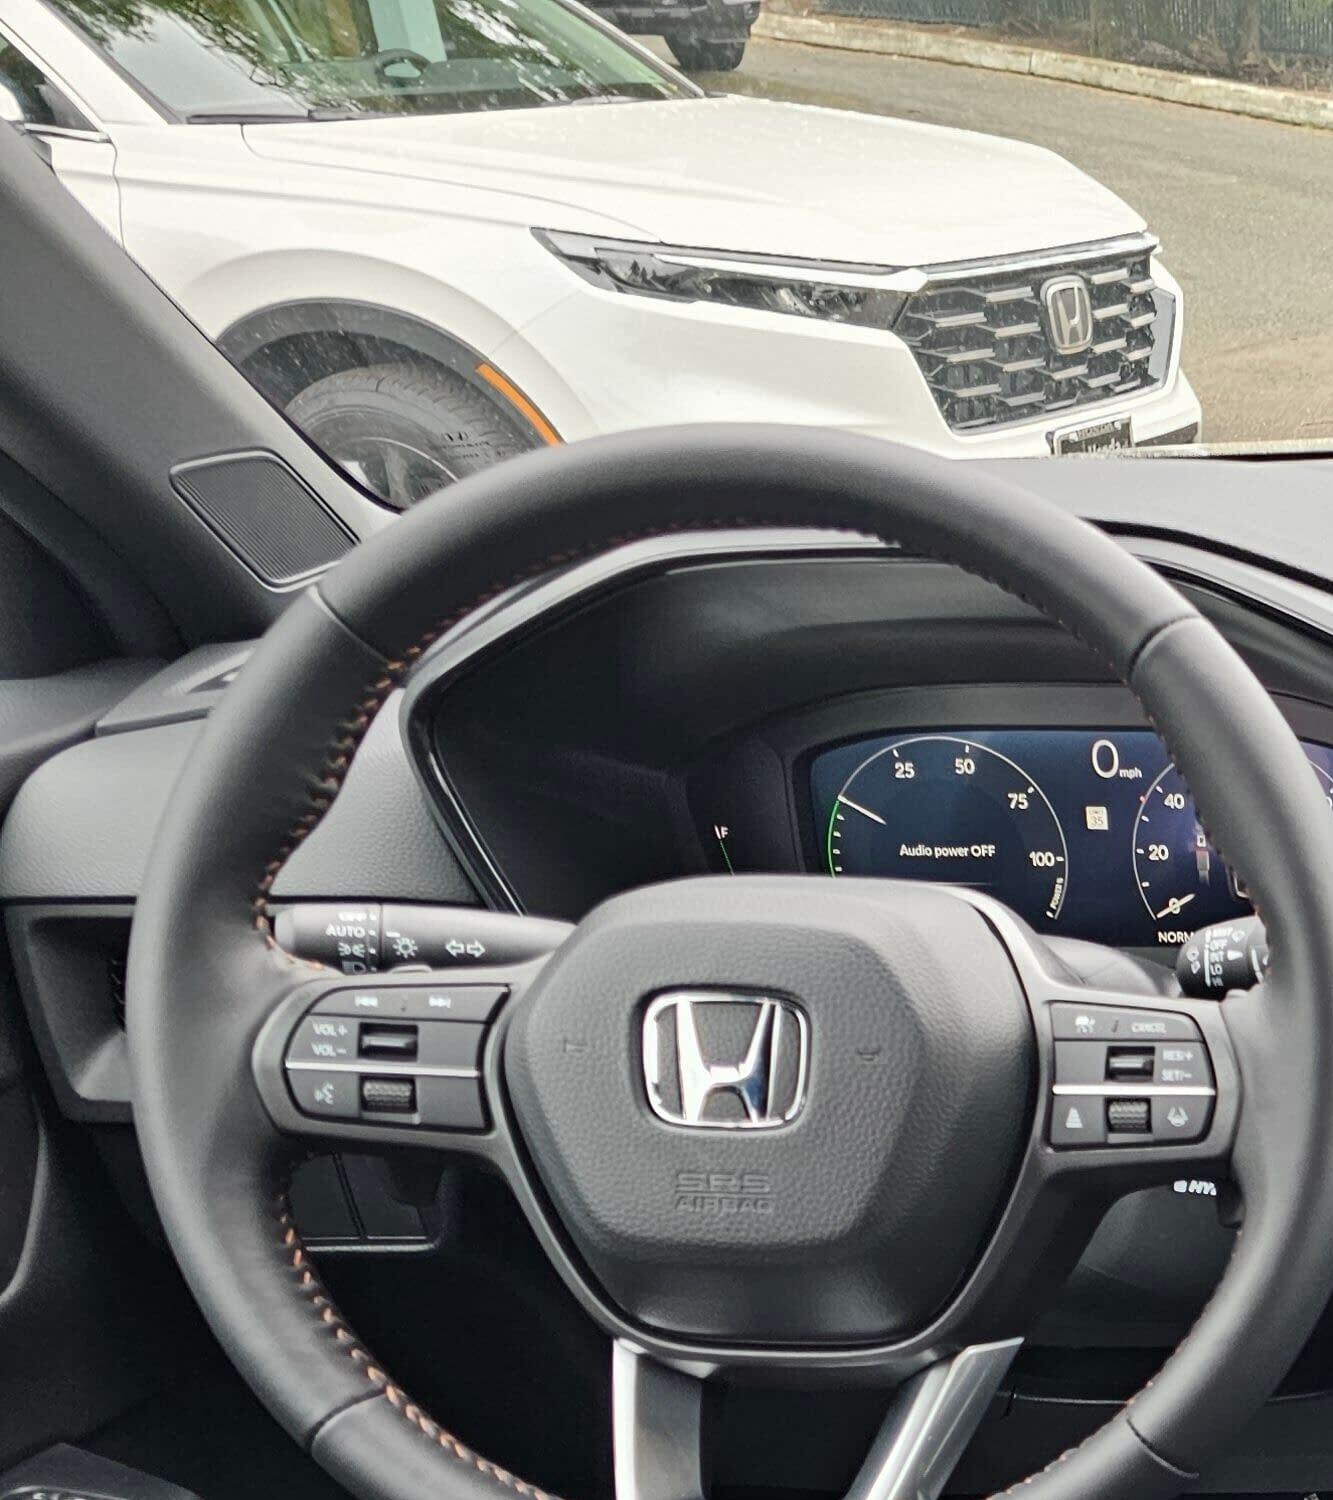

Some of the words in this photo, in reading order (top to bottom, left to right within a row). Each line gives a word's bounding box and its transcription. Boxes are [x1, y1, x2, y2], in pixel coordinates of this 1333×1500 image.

[955, 758, 975, 775] 50
[1092, 739, 1119, 778] 0
[1119, 767, 1142, 780] mph
[894, 762, 915, 779] 25
[1007, 792, 1029, 809] 75
[1164, 793, 1185, 810] 40
[899, 844, 932, 856] Audio
[934, 845, 969, 859] power
[971, 844, 996, 856] OFF
[1029, 851, 1055, 867] 100
[1148, 844, 1169, 861] 20
[325, 924, 366, 938] AUTO
